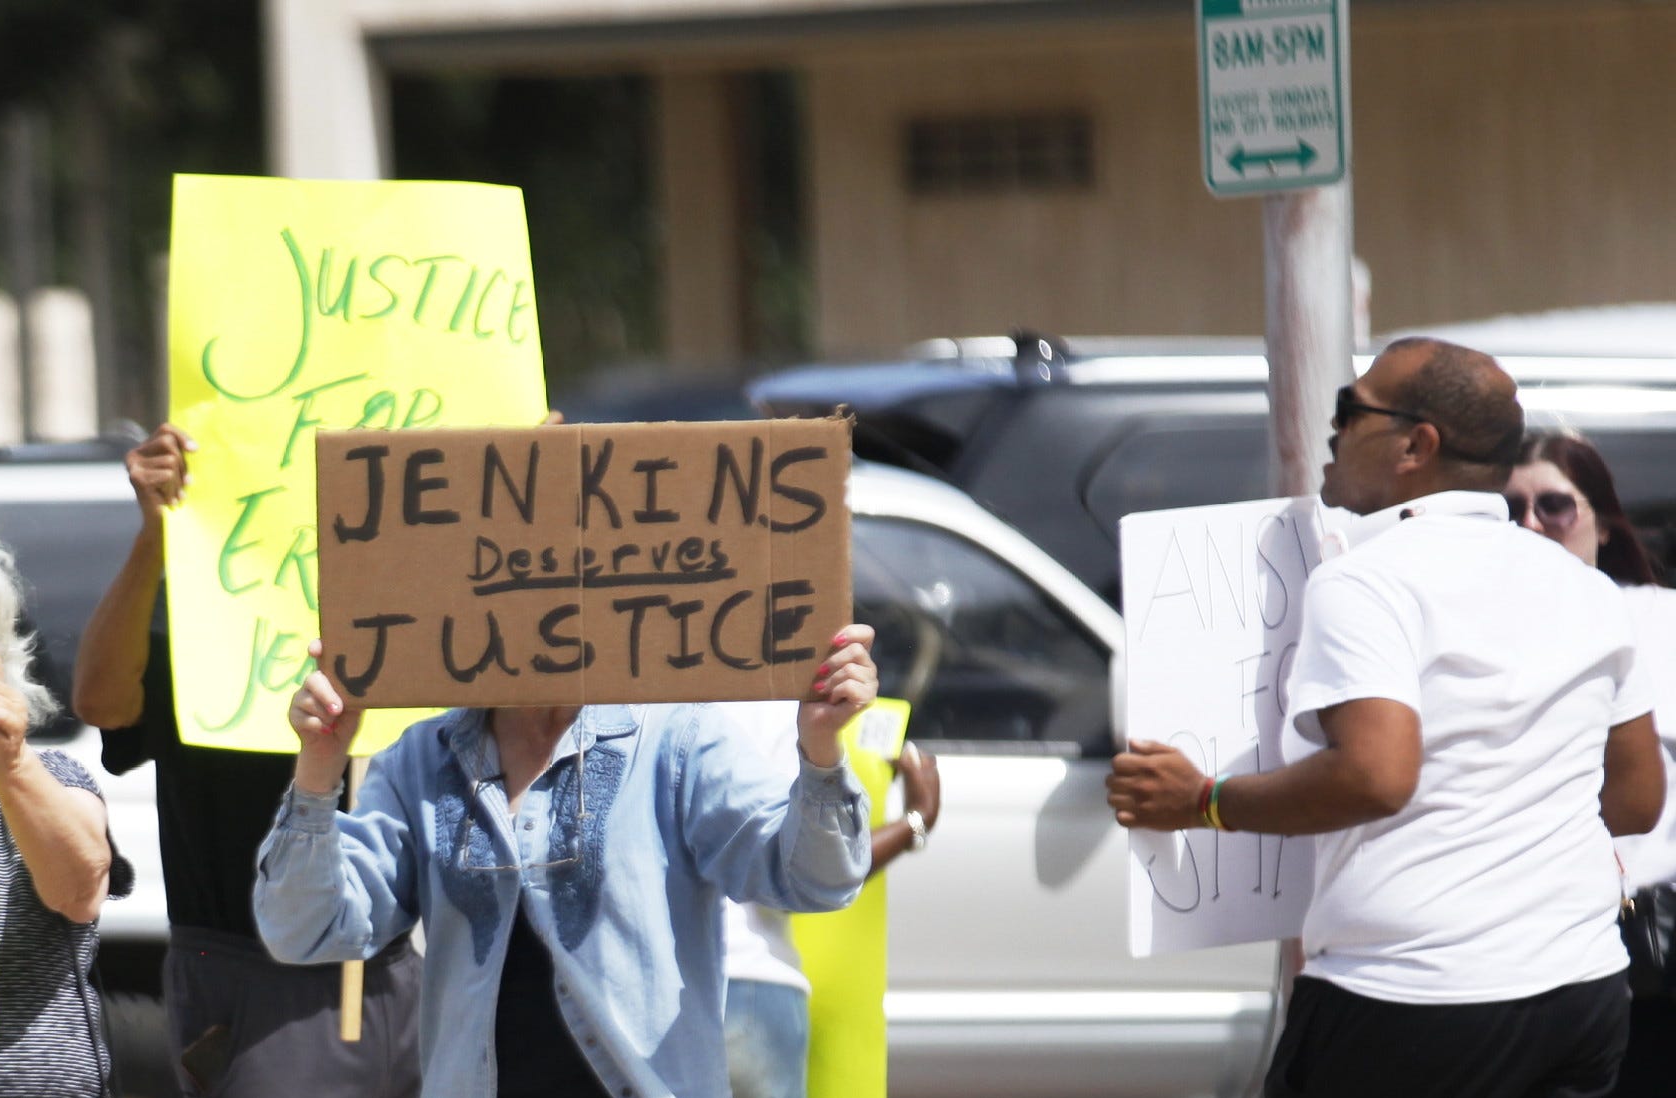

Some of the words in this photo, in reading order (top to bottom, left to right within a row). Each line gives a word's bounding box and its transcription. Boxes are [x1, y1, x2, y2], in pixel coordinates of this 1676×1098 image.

[1213, 24, 1326, 70] 8AM-5PM
[202, 227, 530, 403] JUSTICE
[332, 436, 829, 545] JENKINS
[467, 534, 729, 583] Deserves
[1140, 514, 1311, 640] ANS
[332, 579, 816, 697] JUSTICE
